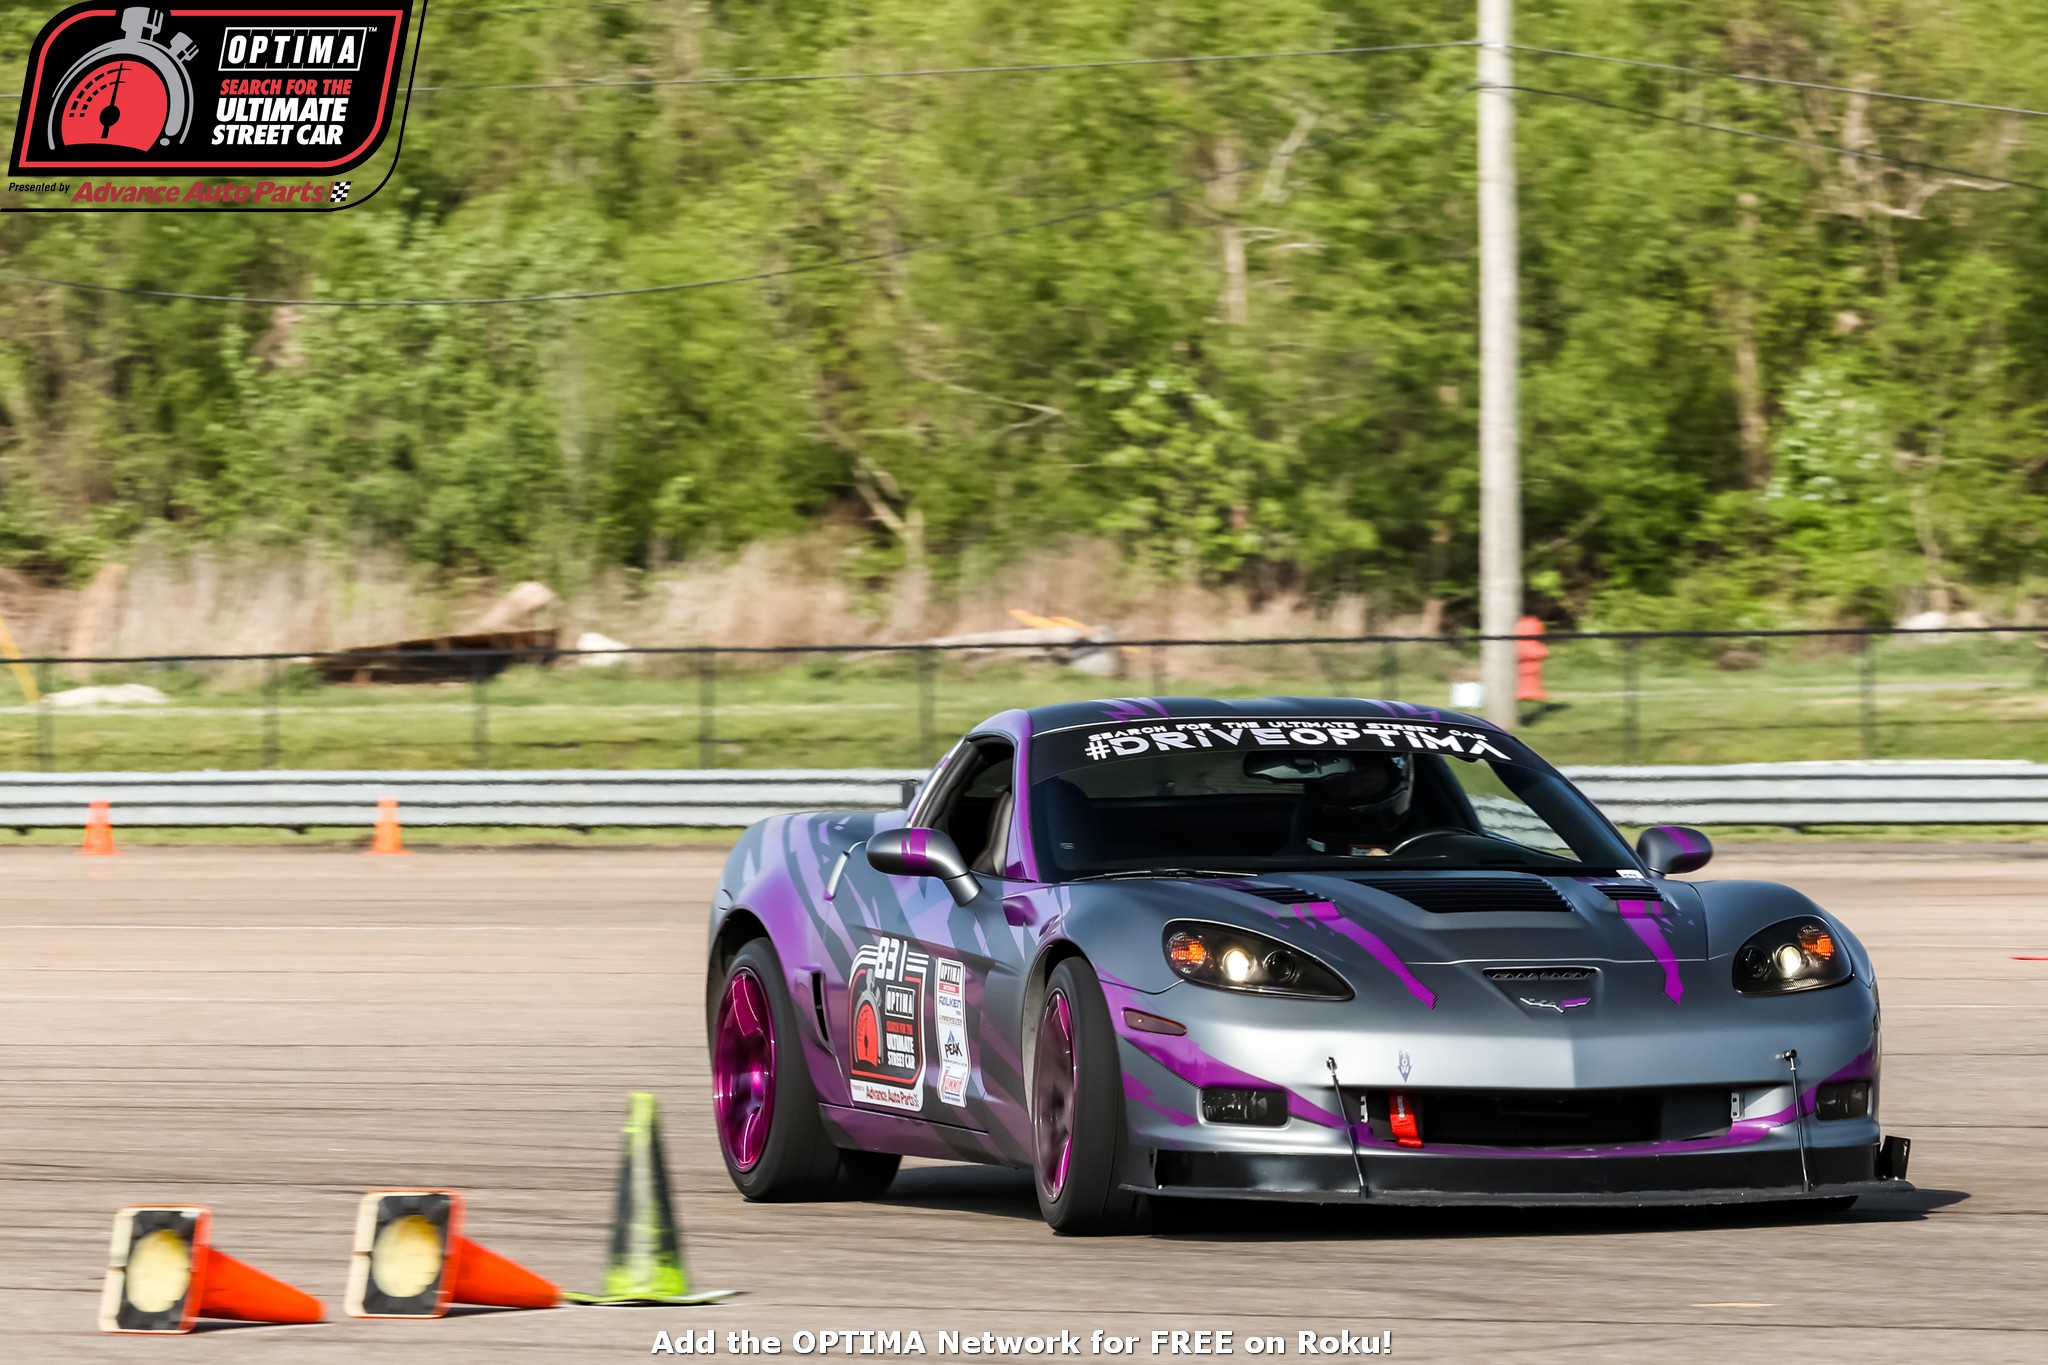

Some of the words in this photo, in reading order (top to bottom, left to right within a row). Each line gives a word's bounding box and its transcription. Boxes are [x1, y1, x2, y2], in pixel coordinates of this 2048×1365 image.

[1088, 725, 1168, 742] SEARCH
[1175, 722, 1214, 732] FOR
[1222, 721, 1261, 729] THE
[1267, 721, 1359, 729] ULTIMATE
[1365, 722, 1439, 734] STREET
[1448, 729, 1489, 742] CAR
[1084, 727, 1512, 761] #DRIVEOPTIMA
[886, 990, 913, 1014] OPTIMA
[886, 1032, 915, 1054] ULTIMATE
[944, 1042, 963, 1058] PEAK
[905, 1054, 916, 1070] CAR
